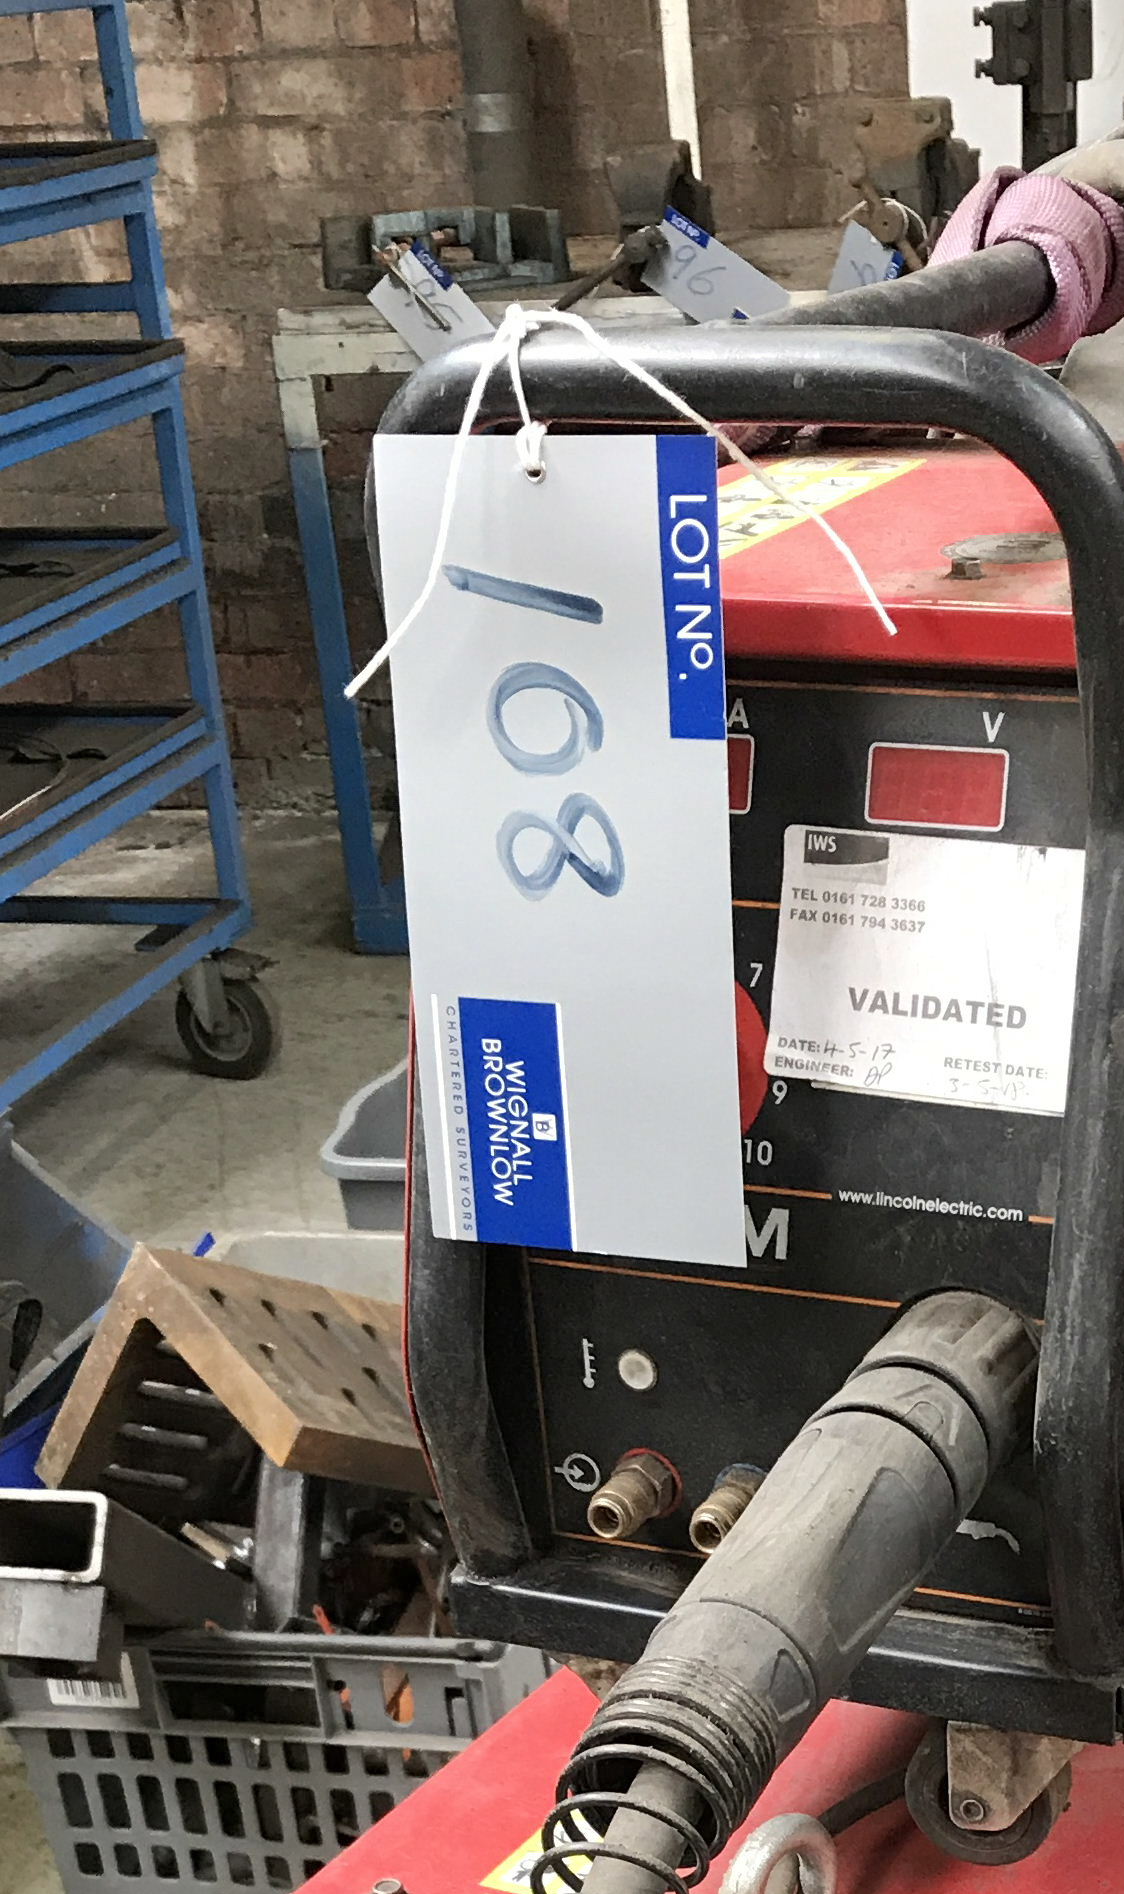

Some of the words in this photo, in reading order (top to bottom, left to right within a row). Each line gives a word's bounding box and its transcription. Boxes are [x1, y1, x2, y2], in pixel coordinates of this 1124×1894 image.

[673, 244, 726, 295] 96
[670, 495, 710, 589] LOT
[727, 699, 750, 729] A
[982, 712, 1005, 743] V
[441, 563, 626, 902] 108
[807, 833, 838, 853] IWS
[791, 887, 818, 902] TEL
[822, 890, 855, 906] 0161
[860, 894, 887, 909] 728
[890, 896, 926, 912] 3366
[790, 908, 818, 922] FAX
[822, 911, 855, 926] 0161
[860, 915, 887, 930] 794
[890, 918, 926, 933] 3637
[749, 963, 763, 986] 7
[847, 986, 1028, 1030] VALIDATED
[777, 1036, 821, 1054] DATE:
[774, 1056, 854, 1077] ENGINEER:
[944, 1056, 1001, 1073] RETEST
[1004, 1063, 1048, 1080] DATE:
[772, 1080, 788, 1104] 9
[446, 1005, 464, 1115] CHARTERED
[455, 1126, 473, 1232] SURVEYORS
[481, 1038, 514, 1206] BROWNLOW
[505, 1060, 533, 1186] WIGNALL
[744, 1139, 773, 1166] 10
[838, 1190, 1024, 1222] www.lincolnelectric.com
